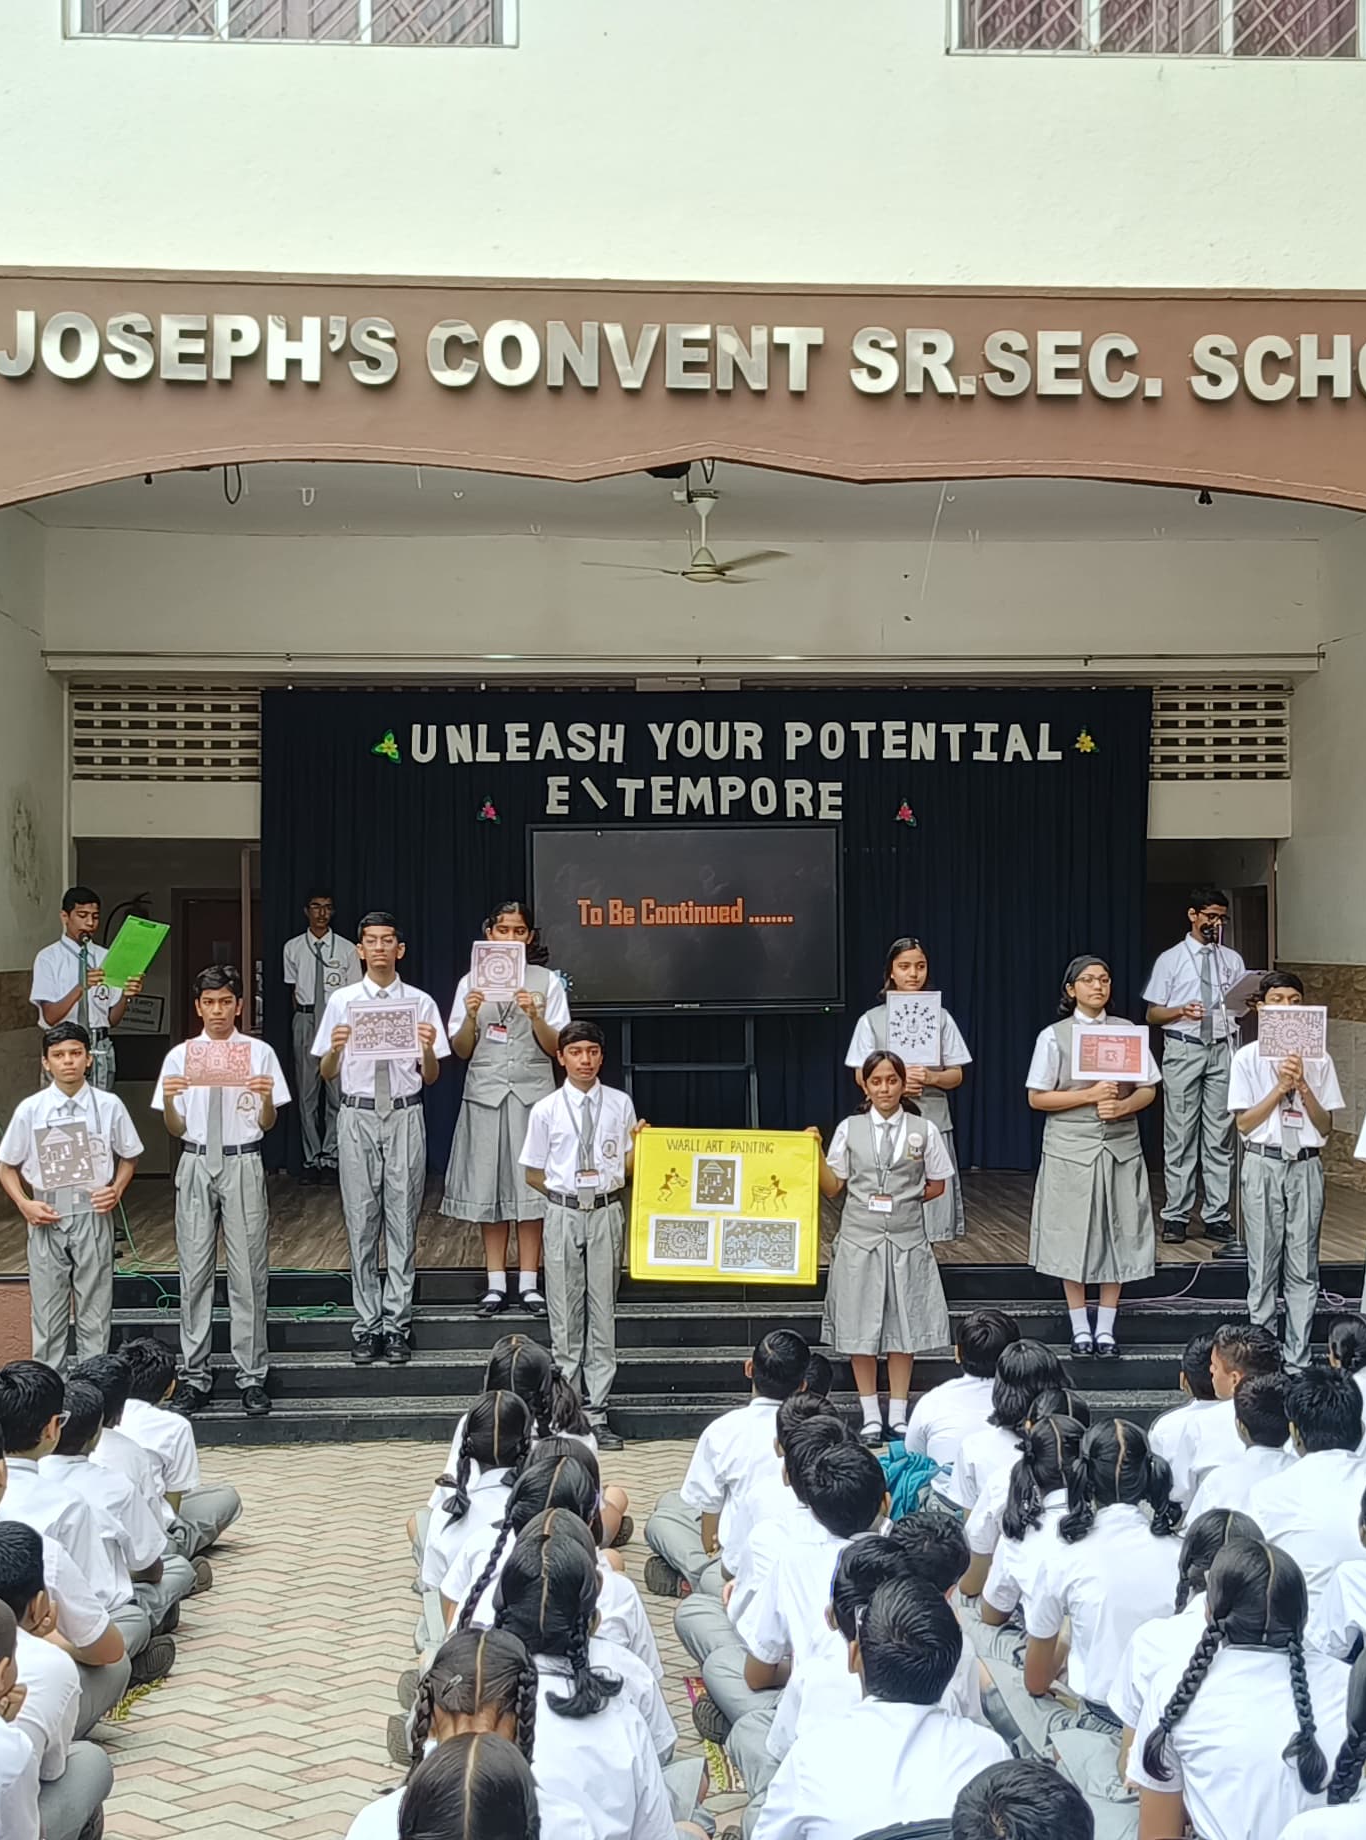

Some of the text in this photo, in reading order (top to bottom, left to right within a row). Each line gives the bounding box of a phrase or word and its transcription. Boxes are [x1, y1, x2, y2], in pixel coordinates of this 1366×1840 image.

[426, 319, 825, 391] CONVENT
[411, 719, 1062, 764] UNLEASH YOUR POTENTIAL
[577, 899, 603, 926] To
[608, 899, 636, 926] Be
[640, 898, 743, 926] Continued
[705, 1139, 724, 1153] ART
[730, 1140, 775, 1154] PAINTING
